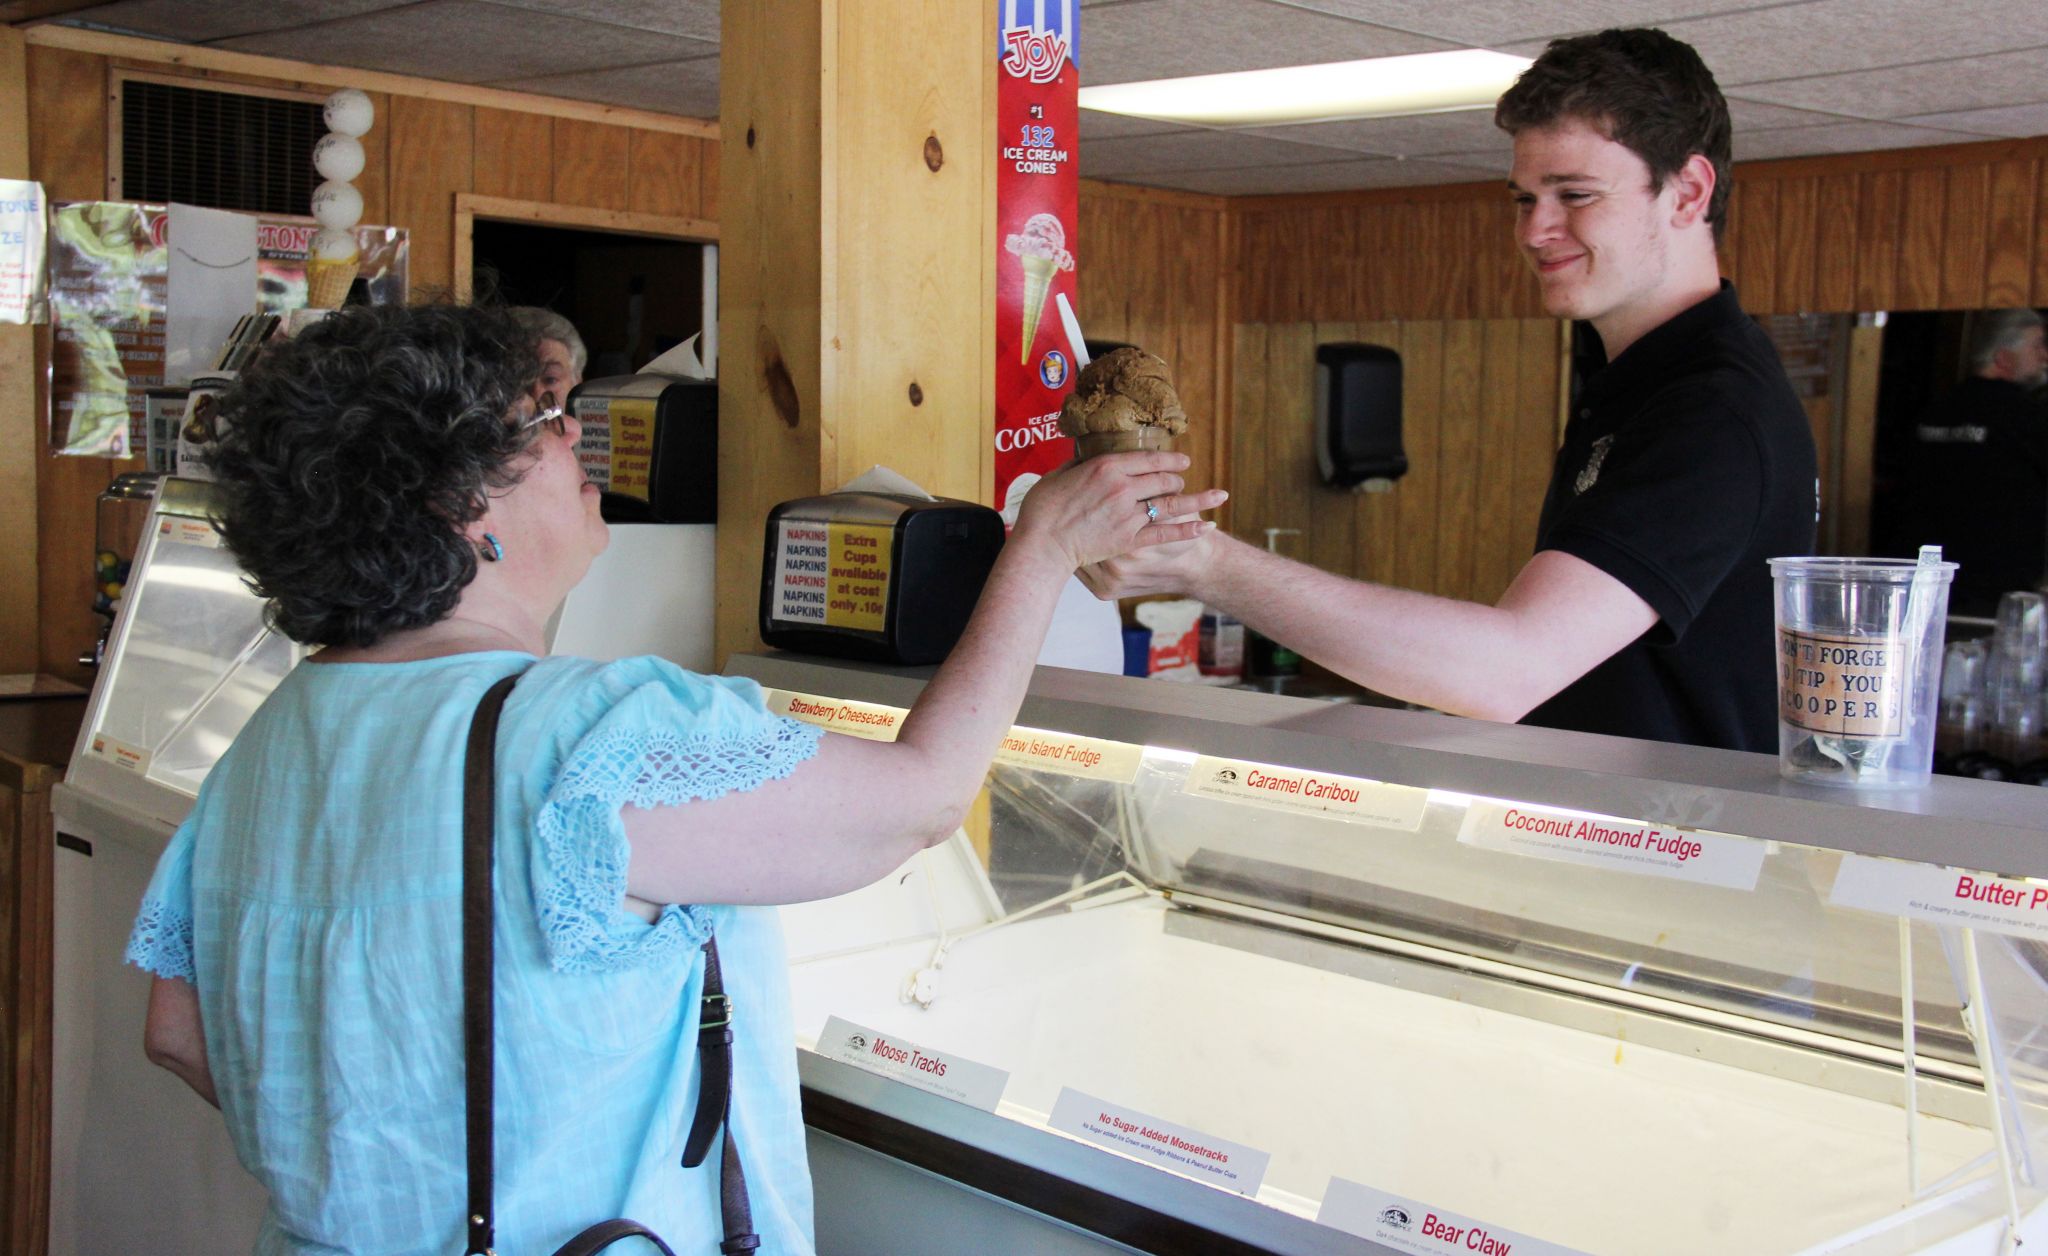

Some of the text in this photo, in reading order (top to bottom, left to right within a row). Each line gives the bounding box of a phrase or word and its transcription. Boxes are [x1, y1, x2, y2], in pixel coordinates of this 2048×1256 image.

[1030, 105, 1043, 118] #1
[1021, 125, 1054, 147] 132
[1004, 148, 1067, 161] ICE CREAM
[1016, 162, 1056, 174] CONES
[0, 199, 39, 214] TONE
[1, 231, 25, 244] ZE
[1028, 416, 1042, 426] ICE
[580, 454, 610, 464] NAPKINS
[585, 468, 609, 478] APKINS
[787, 529, 827, 542] NAPKINS
[844, 533, 877, 547] Extra
[786, 545, 827, 558] NAPKINS
[844, 550, 877, 565] Cups
[785, 559, 826, 572] NAPKINS
[784, 574, 826, 588] NAPKINS
[831, 567, 887, 581] available
[783, 590, 825, 604] NAPKINS
[837, 583, 880, 597] at cost
[782, 605, 825, 618] NAPKINS
[830, 599, 857, 614] only
[1784, 638, 1888, 666] ON'T FORGE
[1797, 669, 1825, 688] TIP
[1786, 689, 1897, 719] COOPERS
[789, 698, 895, 727] Strawberry Cheesecake
[1001, 735, 1028, 753] inaw
[1028, 739, 1064, 759] Island
[1064, 745, 1101, 767] Fudge
[1247, 769, 1303, 794] Caramel
[1304, 779, 1360, 803] Caribou
[1503, 809, 1702, 861] Coconut Almond Fudge
[1955, 875, 2048, 912] Butter P
[872, 1037, 909, 1064] Moose
[910, 1050, 947, 1077] Tracks
[1098, 1112, 1229, 1163] No Sugar Added Moosetracks
[1089, 1124, 1103, 1135] Sugar
[1103, 1129, 1118, 1140] added
[1125, 1136, 1140, 1146] Cream
[1140, 1141, 1152, 1150] with
[1151, 1143, 1166, 1156] Fudge
[1186, 1156, 1191, 1164] &
[1191, 1159, 1208, 1170] Peanut
[1208, 1164, 1224, 1174] Butter
[1224, 1169, 1237, 1179] Cups
[1421, 1213, 1464, 1244] Bear
[1466, 1228, 1511, 1256] Claw
